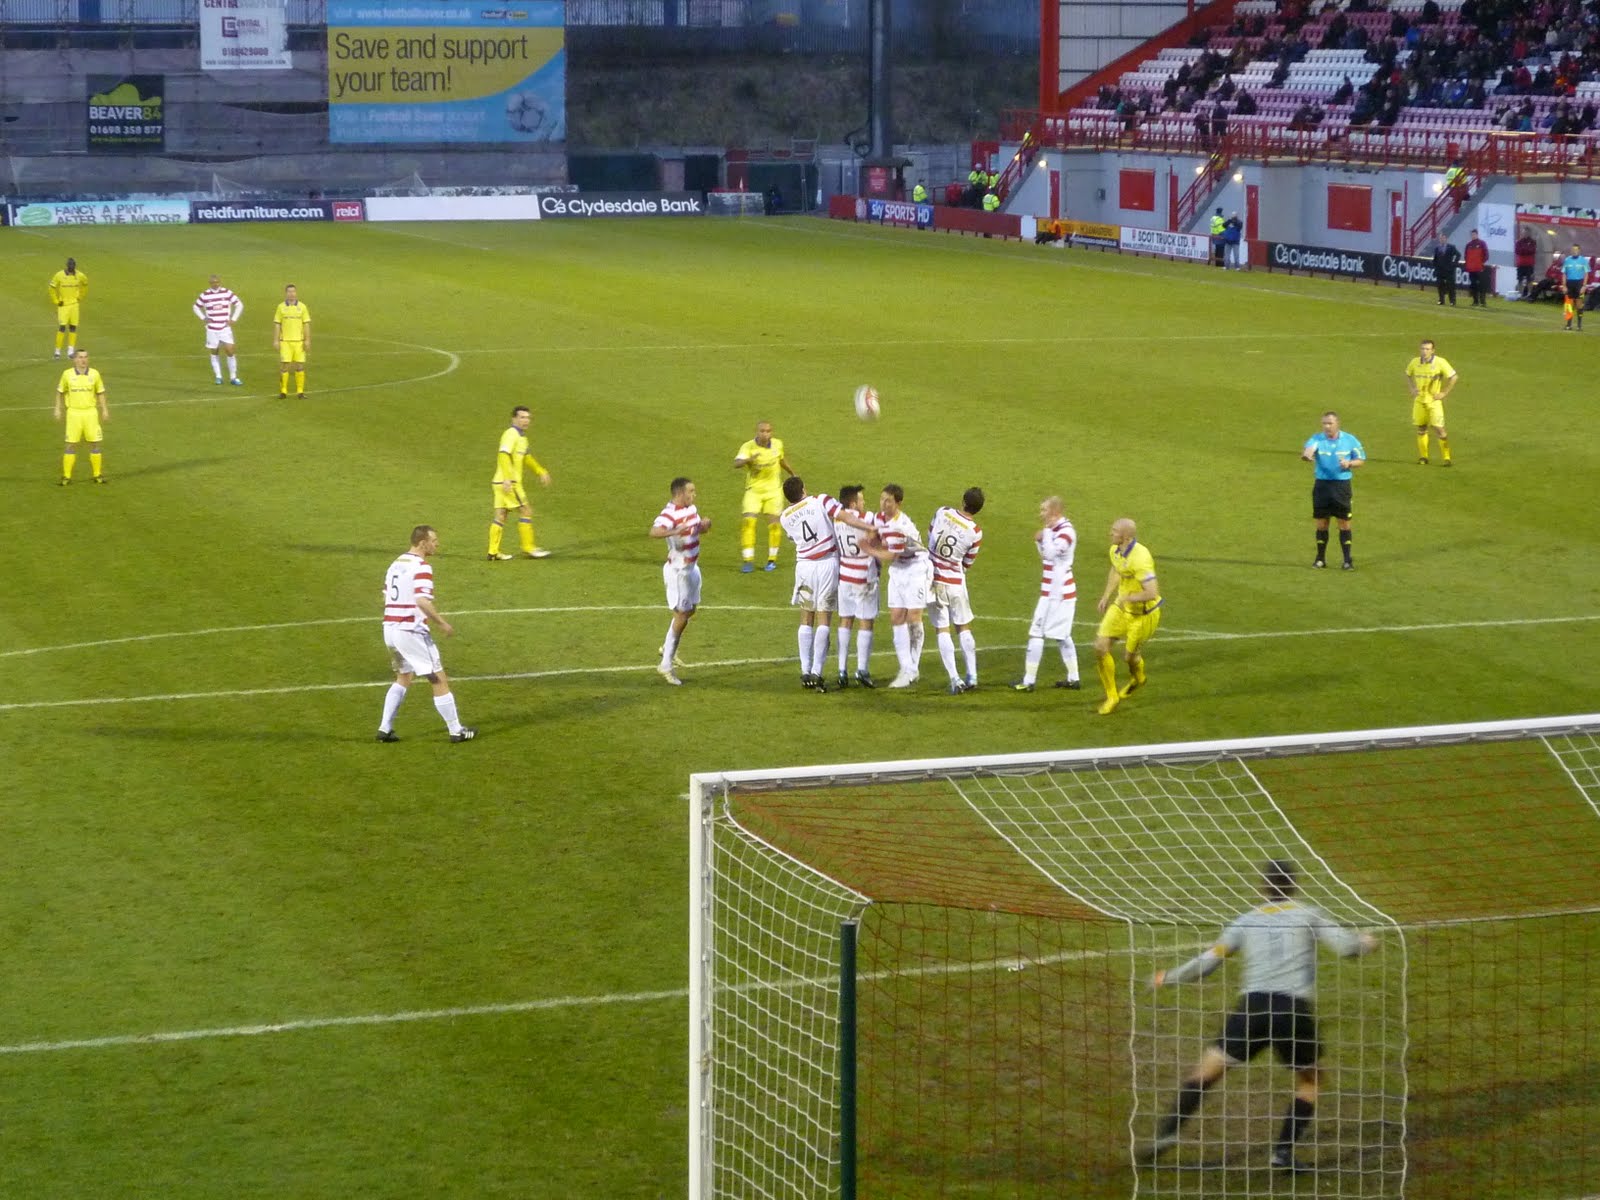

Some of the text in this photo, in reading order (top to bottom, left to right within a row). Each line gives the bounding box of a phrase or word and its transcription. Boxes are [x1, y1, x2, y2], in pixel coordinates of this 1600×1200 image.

[335, 32, 528, 65] Save and support
[335, 65, 451, 98] your team!
[55, 204, 145, 215] FANCY A PINT
[197, 206, 324, 219] reidfurniture.com
[568, 198, 657, 216] Clydesdale
[660, 198, 700, 212] Bank
[871, 201, 930, 223] sky SPORTS HD
[57, 214, 181, 225] AFTER THE MATCH?
[1138, 230, 1155, 243] SCOT
[1156, 232, 1177, 247] TRUCK
[1289, 248, 1339, 270] Clydesdale
[1341, 254, 1364, 273] Bank
[789, 509, 815, 527] CANNING
[802, 520, 819, 543] 4
[838, 534, 861, 556] 15
[934, 529, 958, 558] 18
[391, 575, 400, 602] 5
